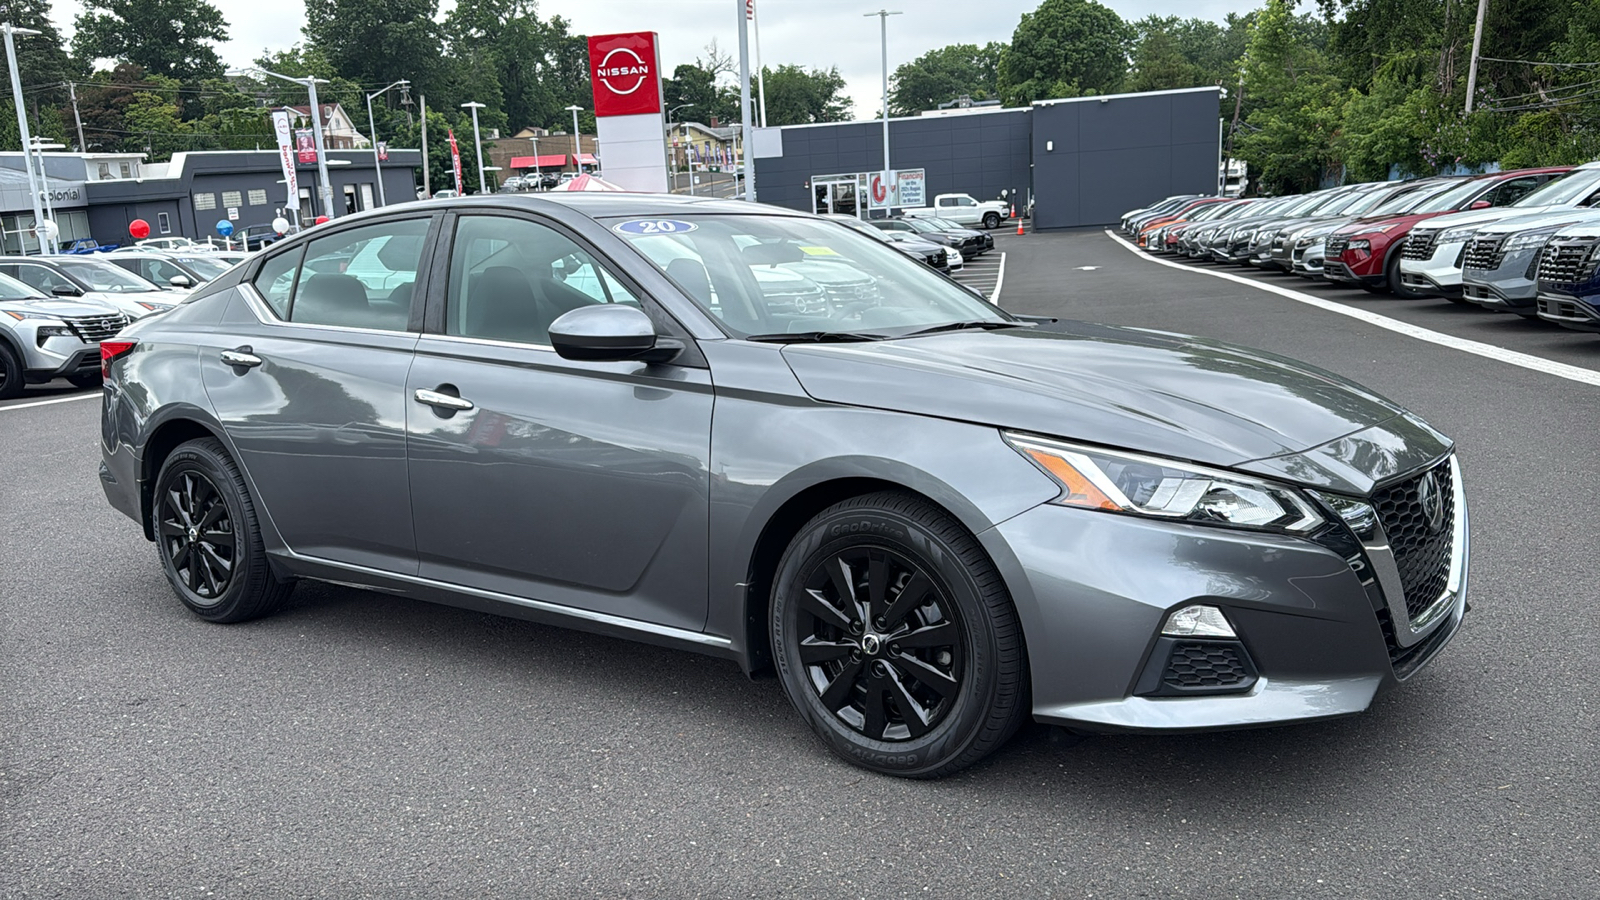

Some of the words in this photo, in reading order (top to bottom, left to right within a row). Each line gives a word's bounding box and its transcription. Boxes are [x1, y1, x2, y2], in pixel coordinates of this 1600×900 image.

[597, 65, 648, 77] NISSAN
[639, 221, 676, 233] 20
[831, 520, 904, 538] GeoDrive
